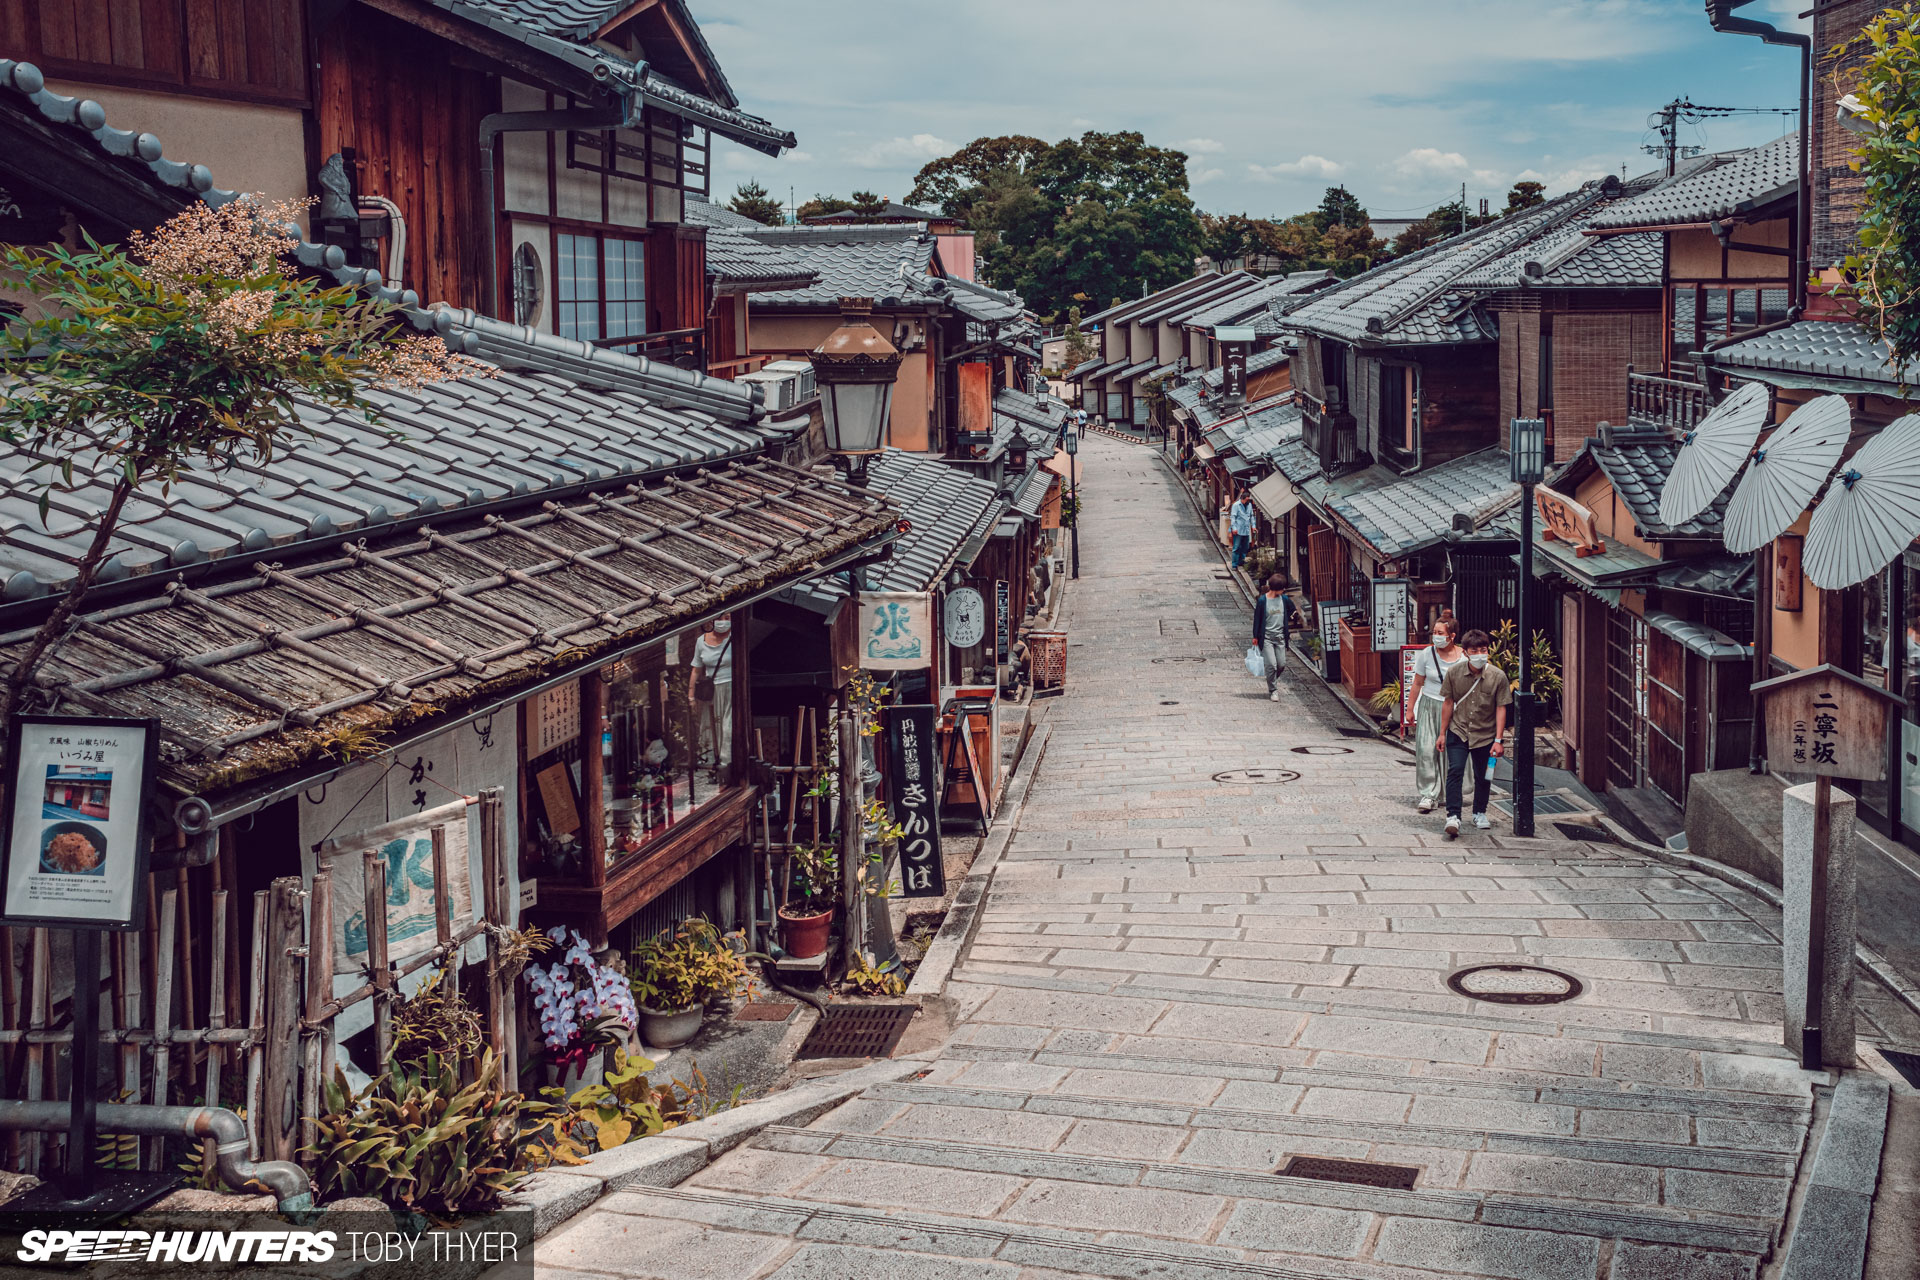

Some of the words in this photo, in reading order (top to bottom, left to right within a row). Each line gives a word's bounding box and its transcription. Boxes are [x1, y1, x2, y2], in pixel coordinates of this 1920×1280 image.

[1377, 617, 1388, 645] ふたば
[49, 737, 70, 745] 京風味
[77, 738, 119, 748] 山椒ちりめん
[1793, 720, 1807, 764] (二年坂)
[1811, 692, 1839, 765] 二寧坂
[60, 750, 105, 762] いづみ屋
[902, 783, 932, 891] きんつば
